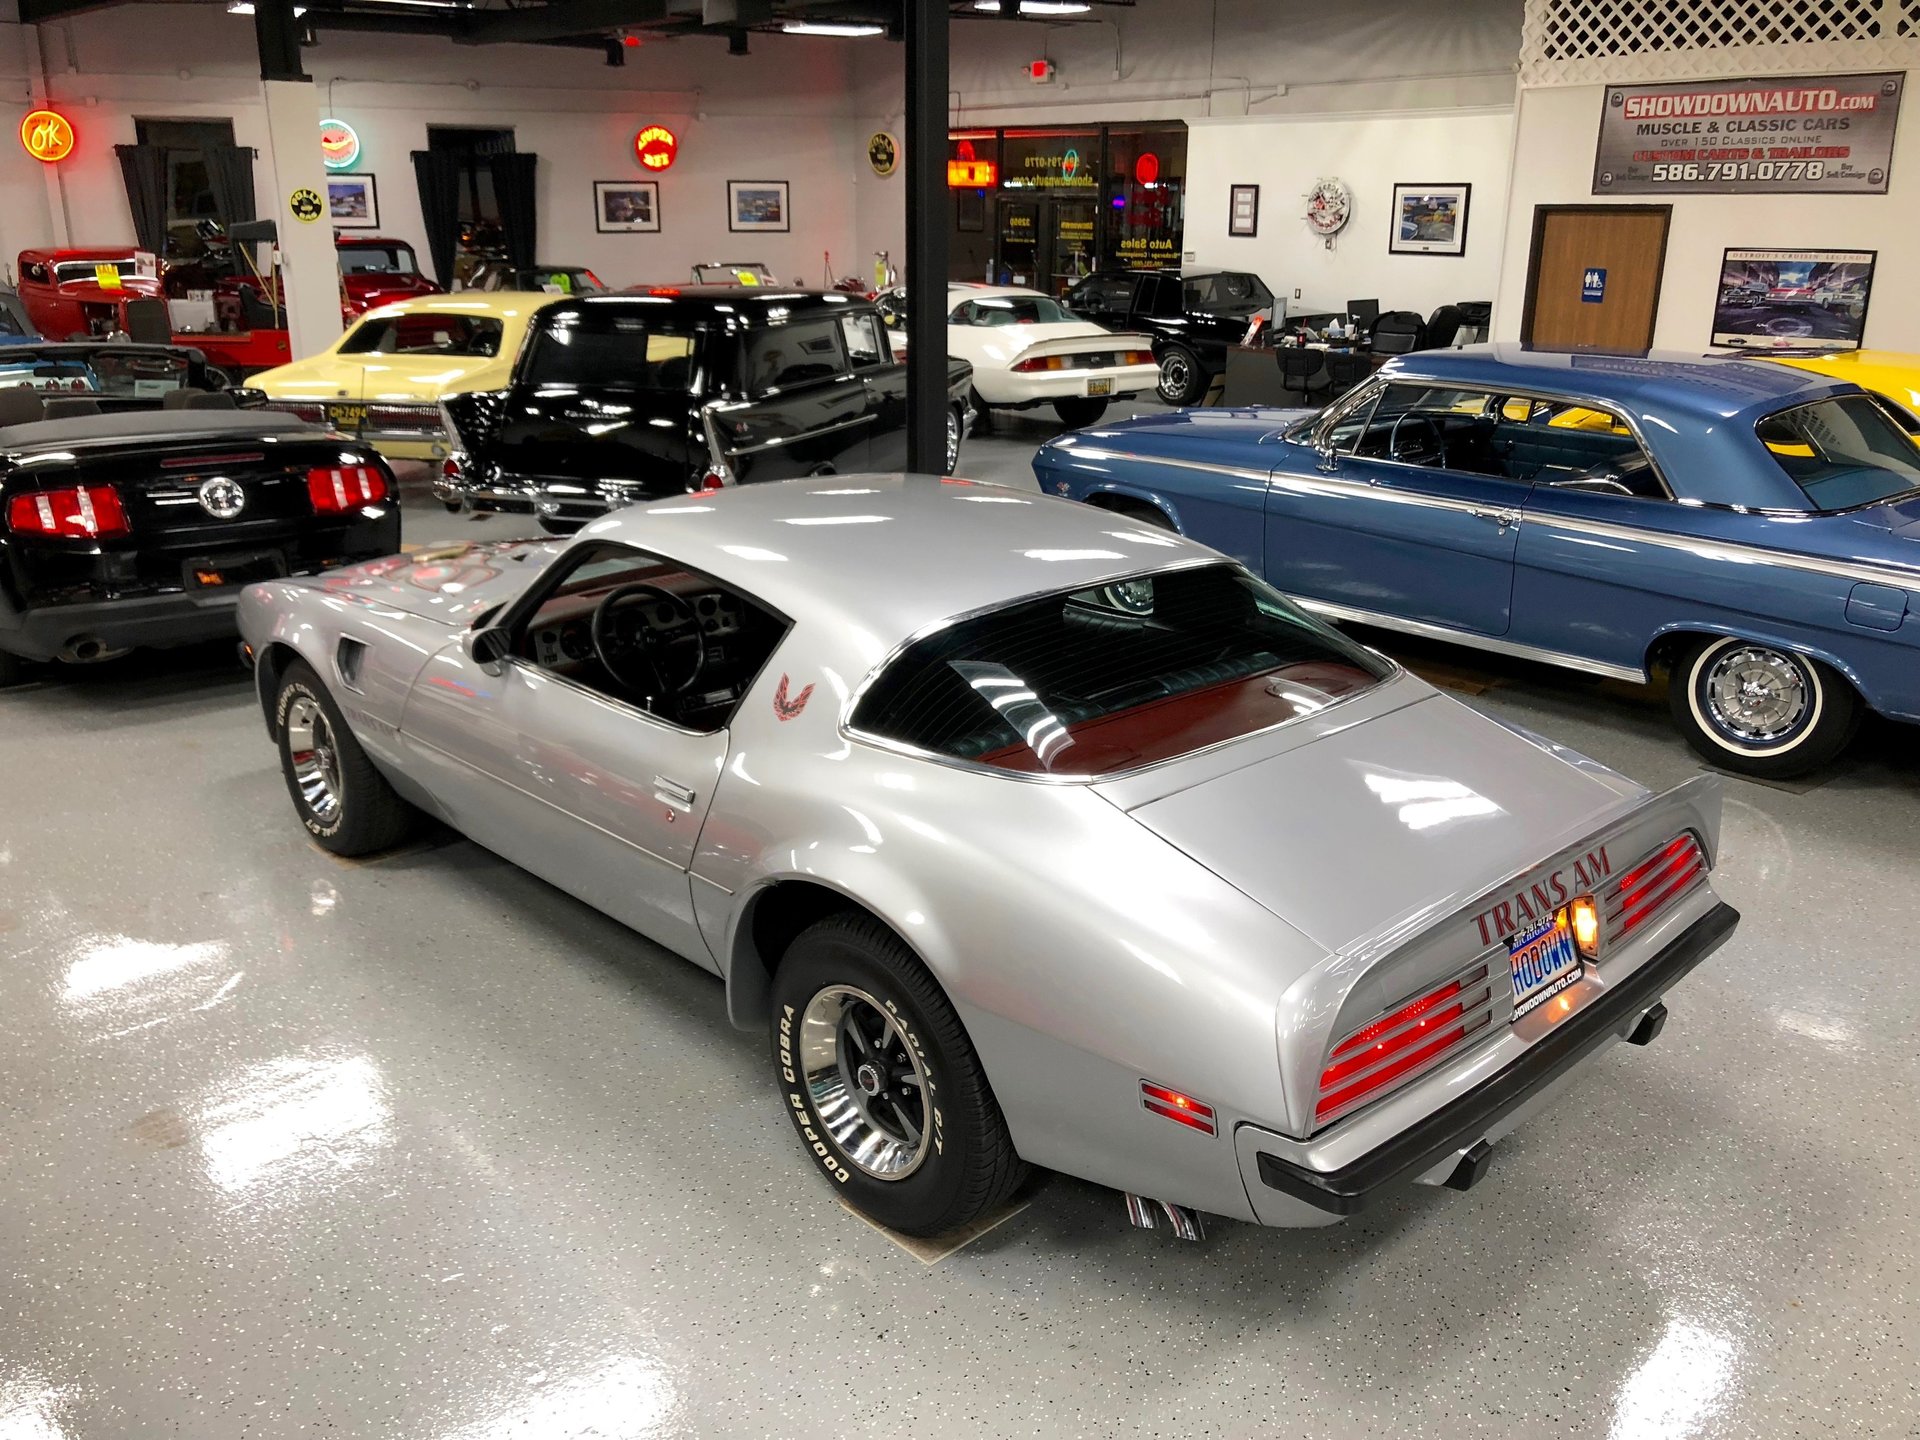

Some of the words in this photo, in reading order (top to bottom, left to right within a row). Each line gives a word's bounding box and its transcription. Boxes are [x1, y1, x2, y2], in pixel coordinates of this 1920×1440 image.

[1625, 89, 1875, 118] SHOWDOWNAUTO.COM
[31, 119, 63, 151] OK
[637, 127, 674, 151] SUPER
[1636, 122, 1702, 136] MUSCLE
[1706, 120, 1720, 134] &
[1725, 119, 1799, 133] CLASSIC
[1803, 117, 1851, 131] CARS
[1660, 137, 1689, 147] OVER
[1694, 136, 1717, 146] 150
[1722, 136, 1776, 146] CLASSICS
[1781, 134, 1822, 145] ONLINE
[1633, 149, 1695, 162] CUSTOM
[1697, 148, 1750, 160] CARTS
[1751, 147, 1765, 159] &
[1652, 161, 1824, 181] 586.791.0778
[1470, 870, 1568, 947] TRANS
[1573, 846, 1611, 894] AM
[1511, 922, 1552, 950] MICHIGAN
[779, 1004, 796, 1084] COBRA
[884, 999, 937, 1097] RADIAL
[789, 1093, 850, 1184] COOPER
